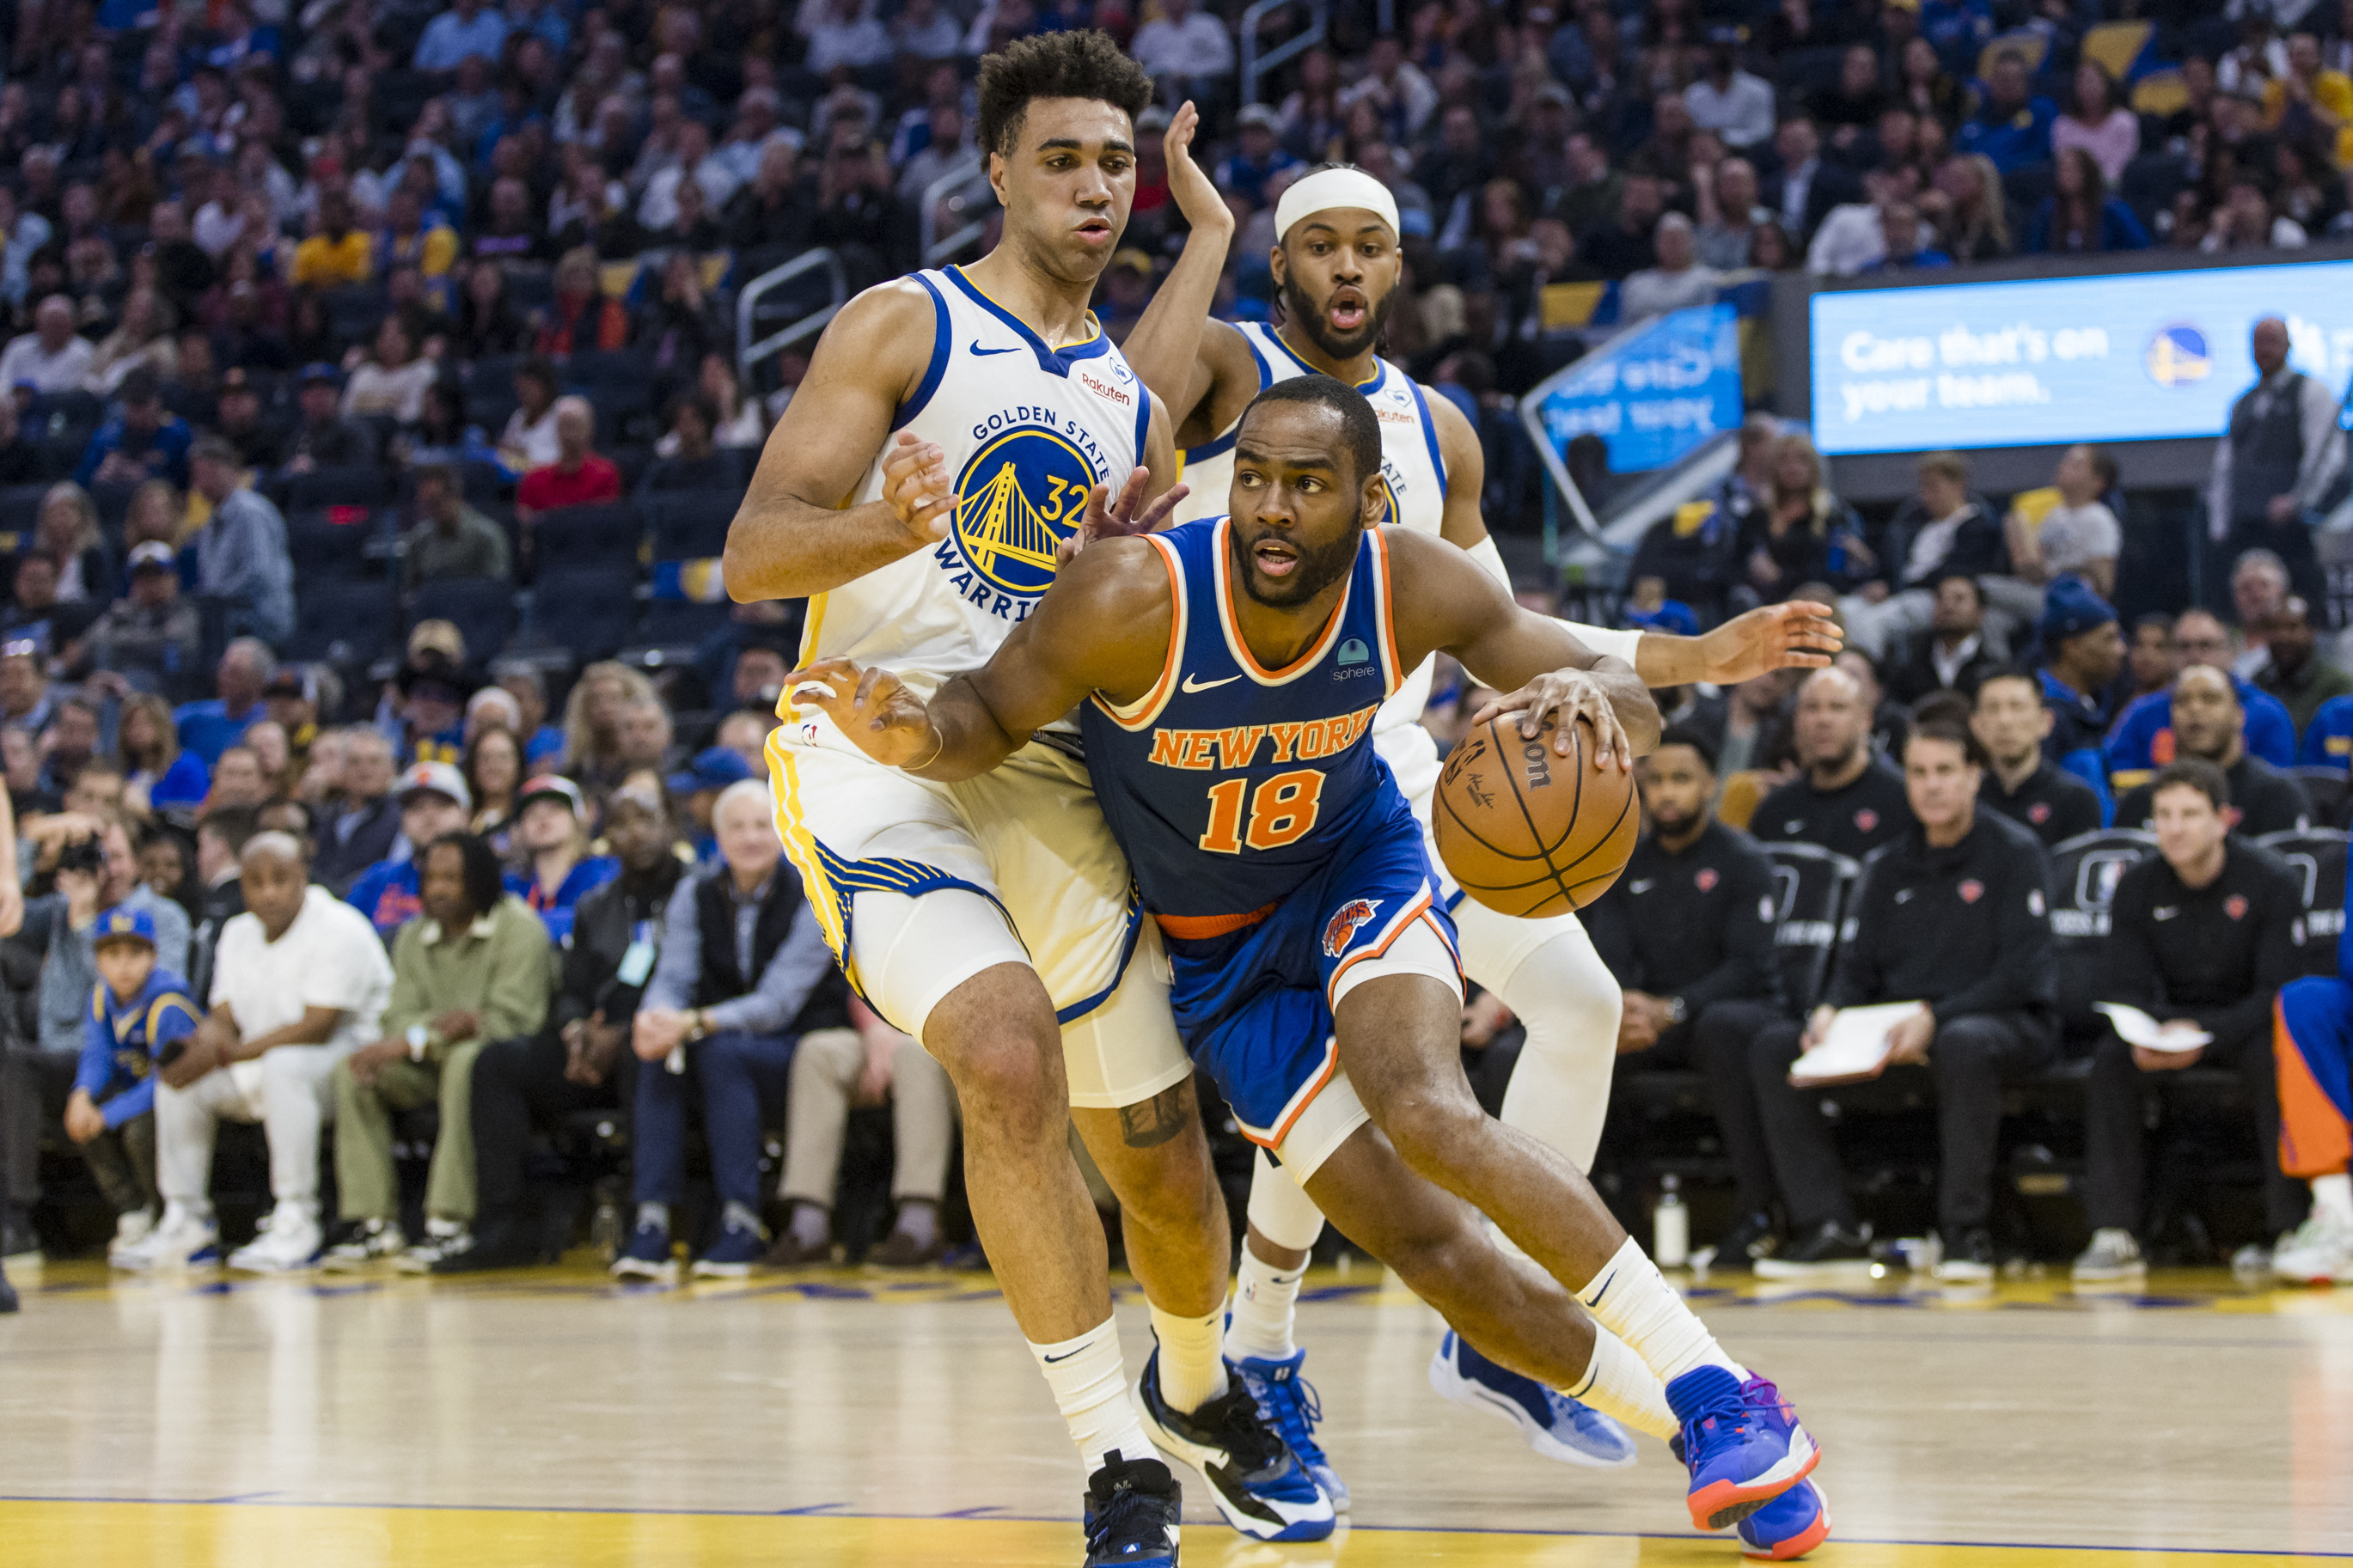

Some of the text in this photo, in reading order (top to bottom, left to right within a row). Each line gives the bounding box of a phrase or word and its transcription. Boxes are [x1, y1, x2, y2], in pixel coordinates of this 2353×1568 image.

[1842, 331, 1934, 371] Care
[1082, 373, 1130, 406] Rakuten
[1375, 408, 1415, 424] akuten
[973, 406, 1110, 481] GOLDEN STATE
[1381, 455, 1407, 496] ATE
[1040, 474, 1090, 529] 32
[933, 537, 1042, 622] WARRI
[1333, 666, 1375, 682] sphere
[1147, 705, 1378, 771] NEW YORK
[1199, 768, 1327, 856] 18
